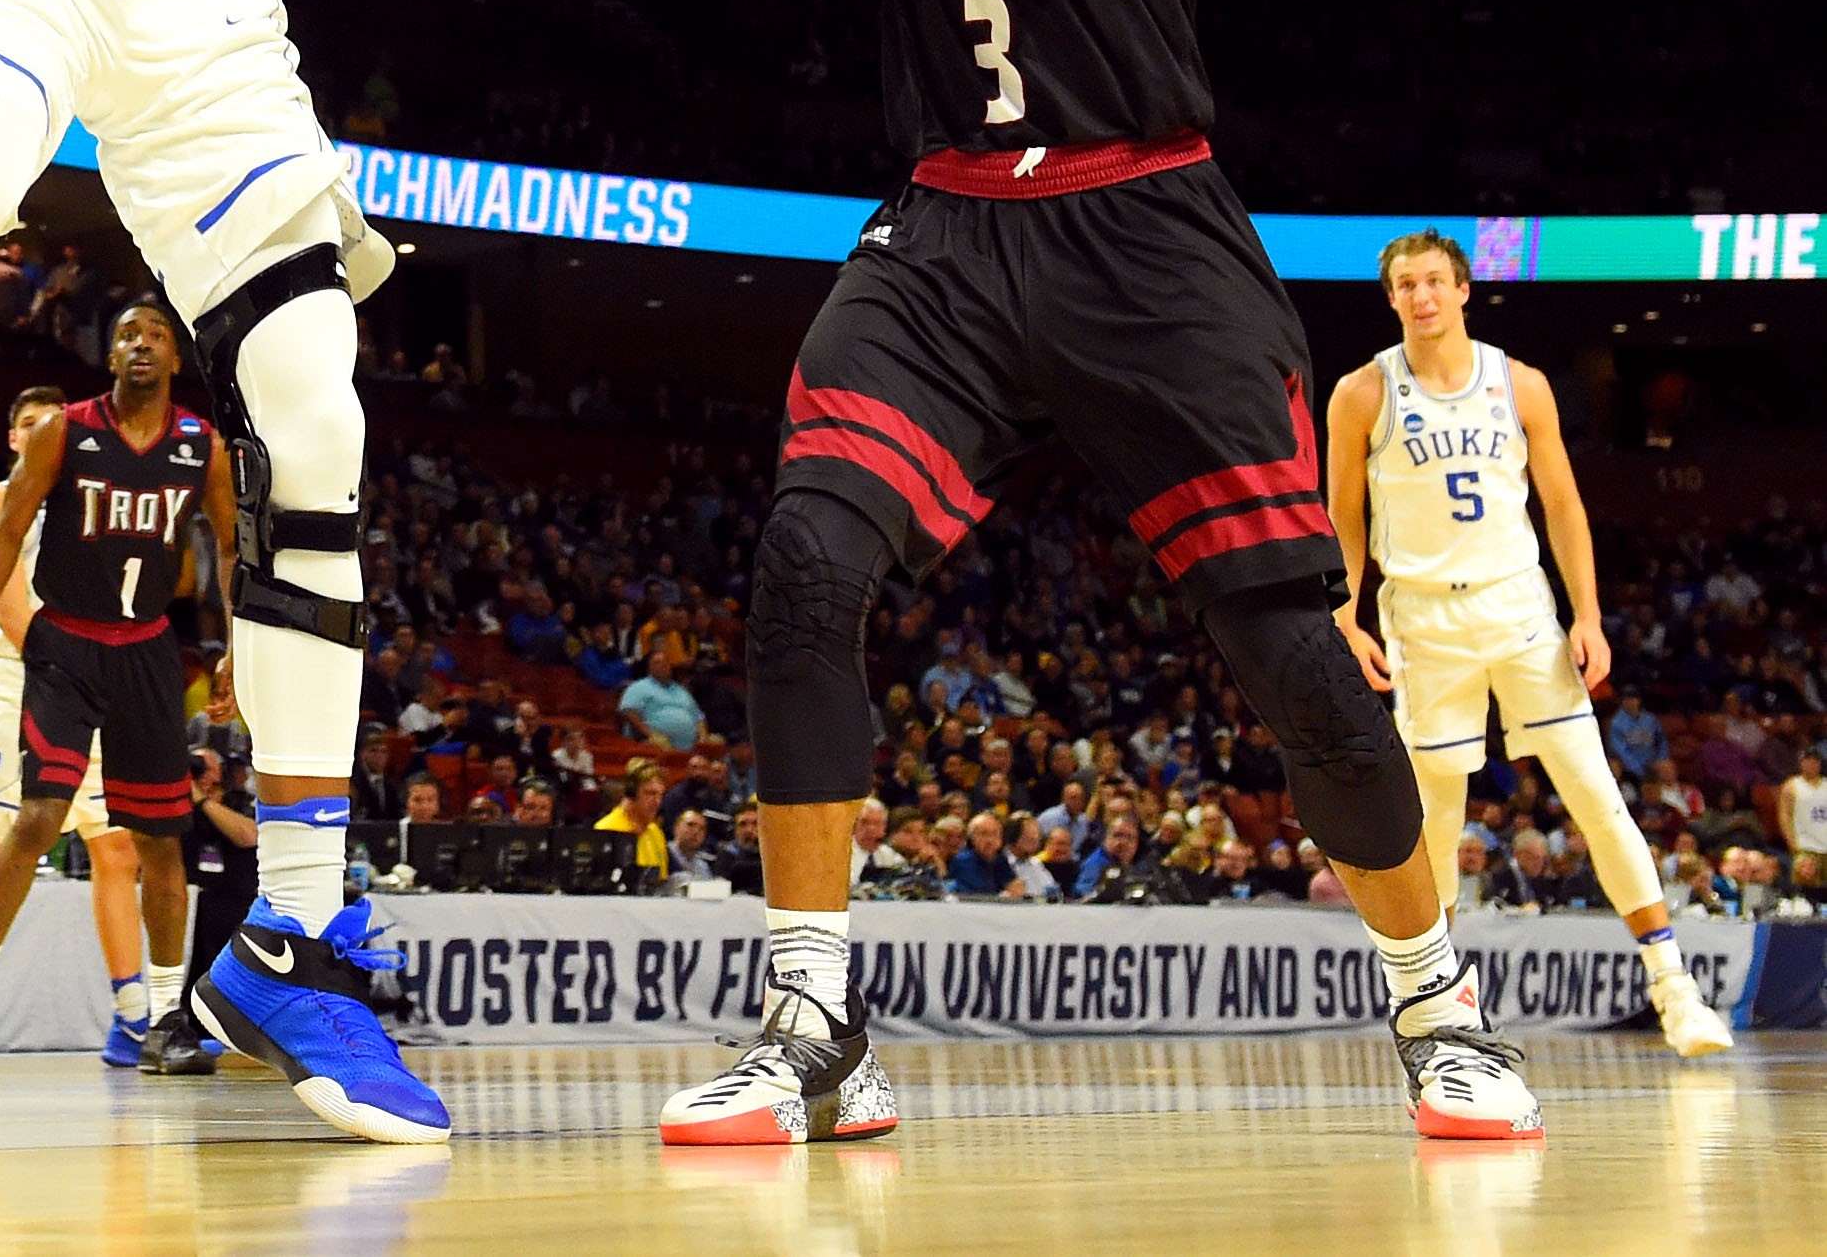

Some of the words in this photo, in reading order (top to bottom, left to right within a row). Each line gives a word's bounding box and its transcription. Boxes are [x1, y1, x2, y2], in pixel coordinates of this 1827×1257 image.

[1691, 213, 1820, 280] THE
[1403, 428, 1509, 467] DUKE
[76, 477, 192, 546] TROY
[1446, 471, 1484, 522] 5
[120, 557, 142, 619] 1
[397, 938, 616, 1027] HOSTED
[636, 939, 702, 1021] BY
[710, 938, 927, 1019] FUAN
[944, 941, 1210, 1021] UNIVERSITY
[1217, 944, 1302, 1019] AND
[1518, 949, 1730, 1018] CONFERCE
